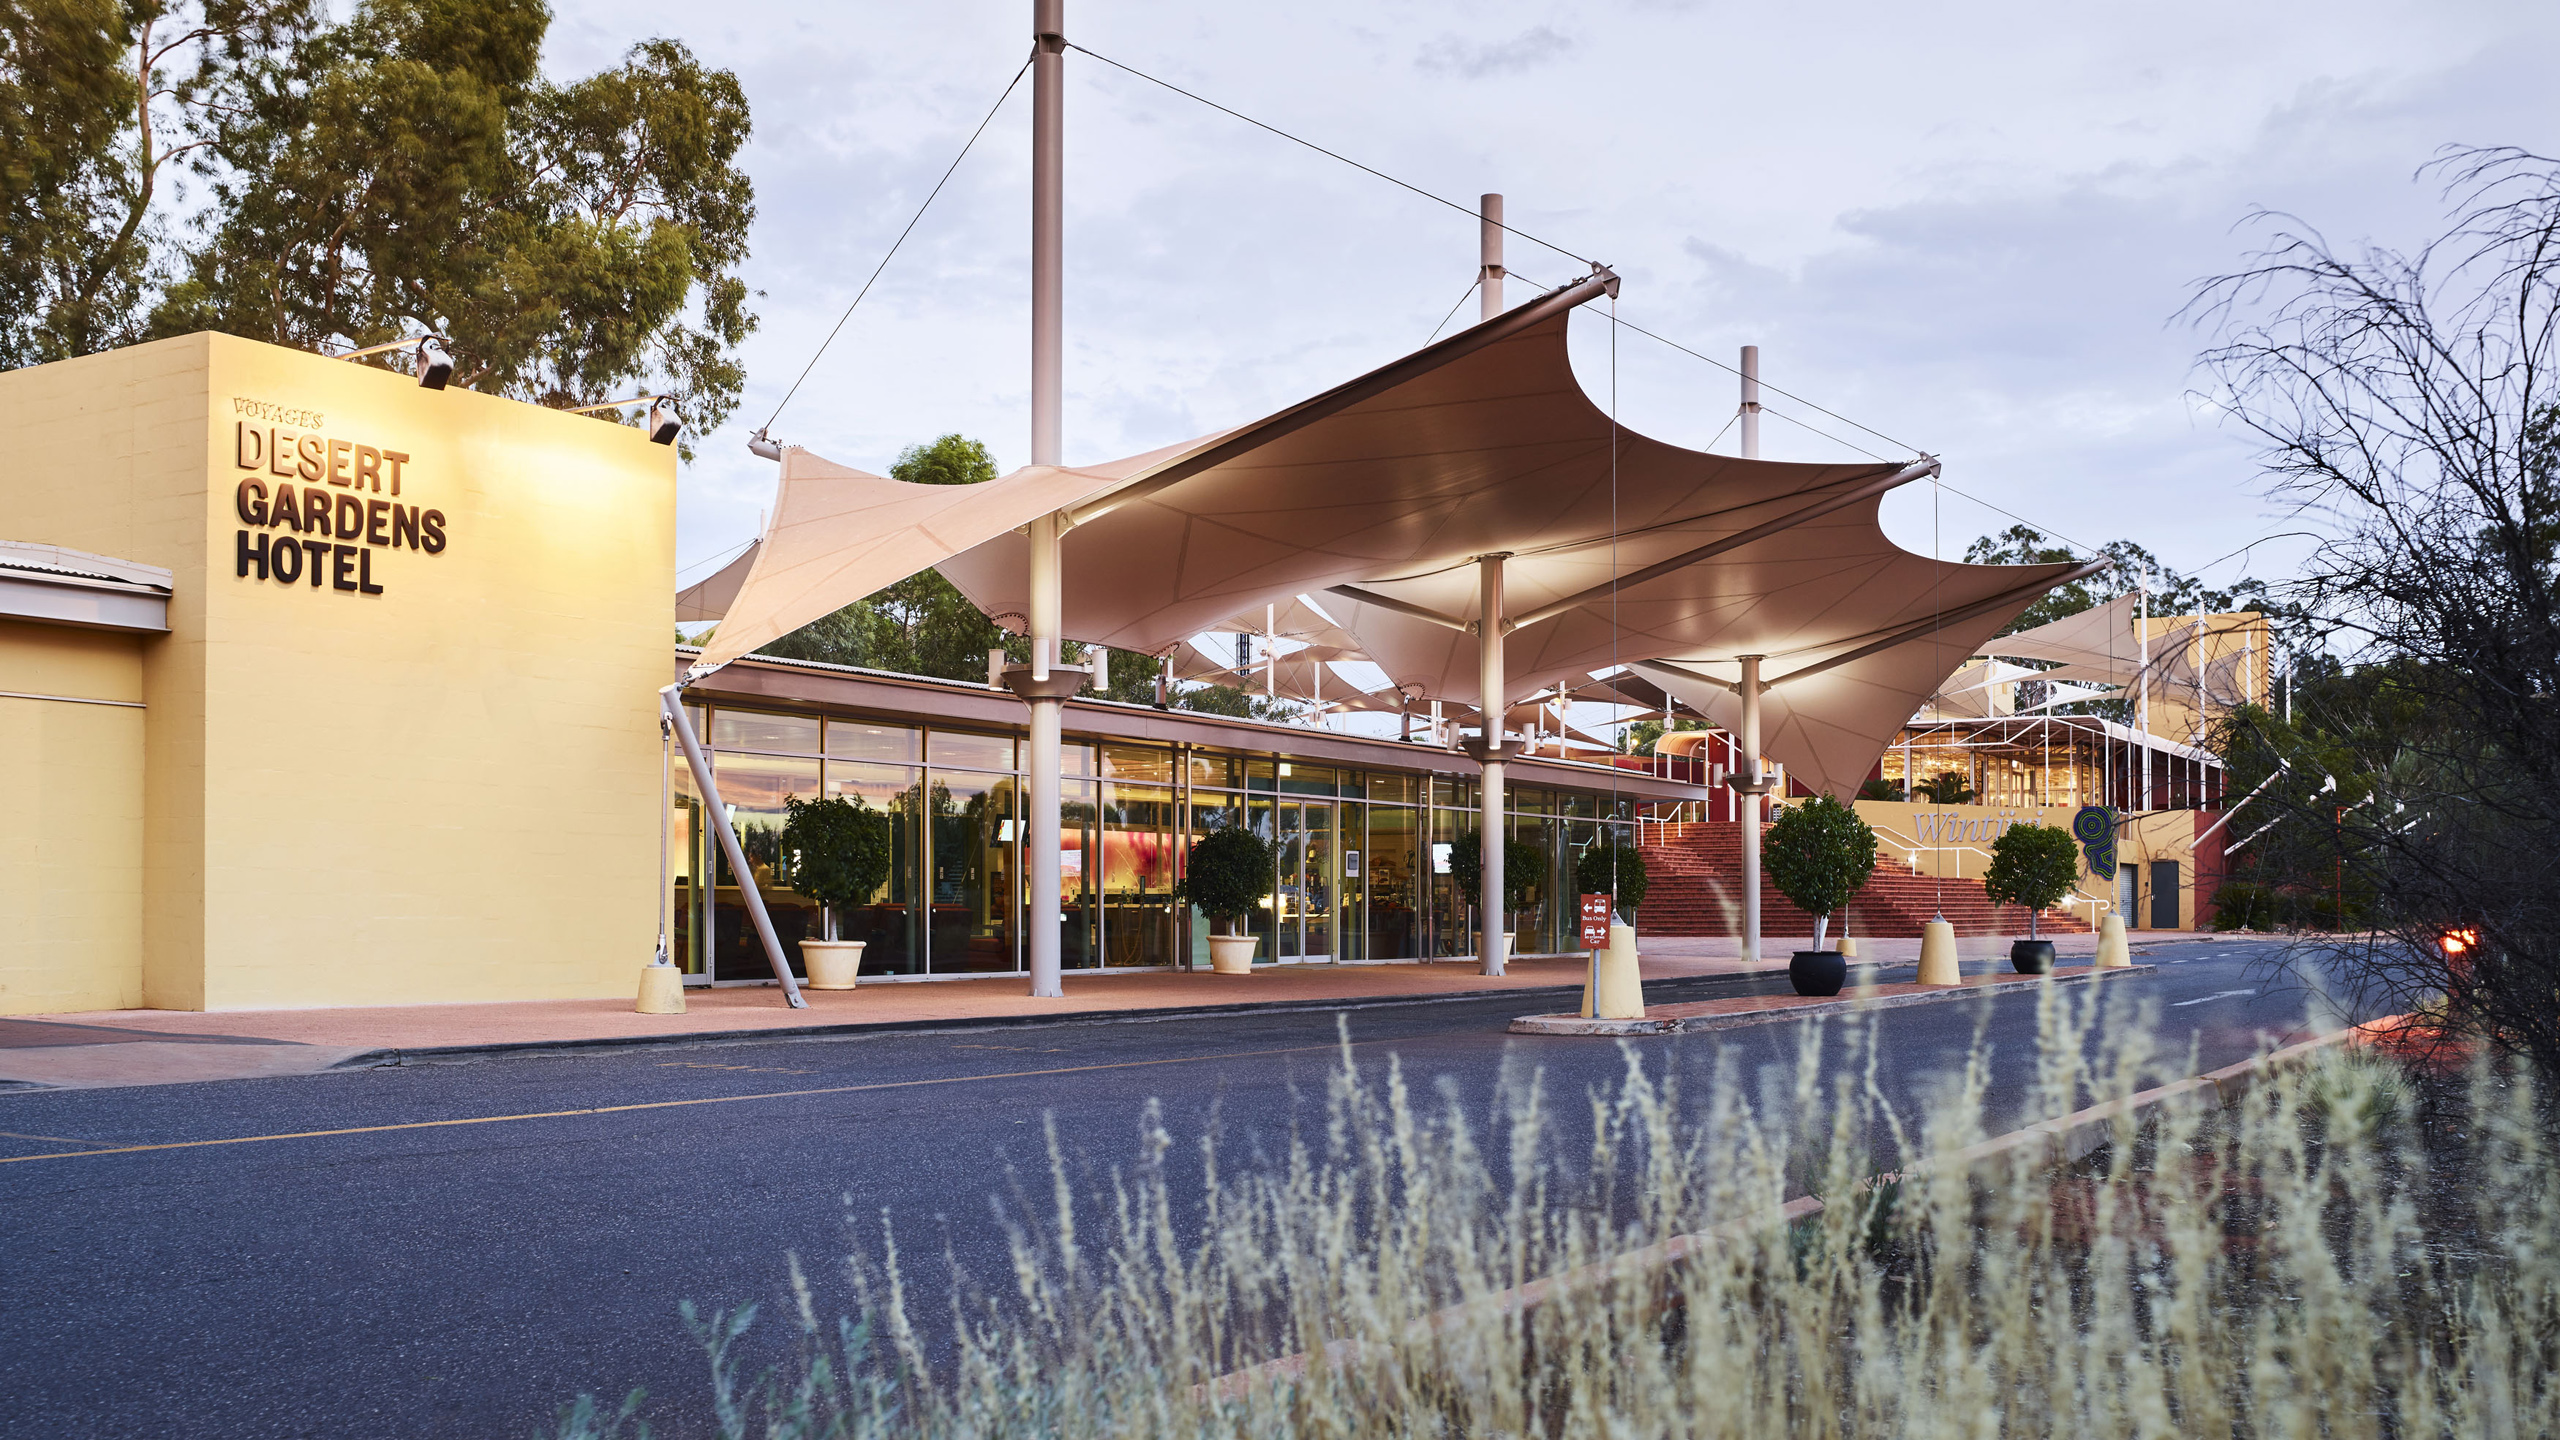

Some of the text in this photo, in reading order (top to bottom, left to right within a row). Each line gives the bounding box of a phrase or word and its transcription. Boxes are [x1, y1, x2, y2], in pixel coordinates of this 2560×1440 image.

[233, 397, 324, 430] VOYAGES
[238, 421, 410, 496] DESERT
[237, 477, 447, 553] GARDENS
[237, 530, 383, 594] HOTEL
[1913, 810, 2043, 849] Wintjii
